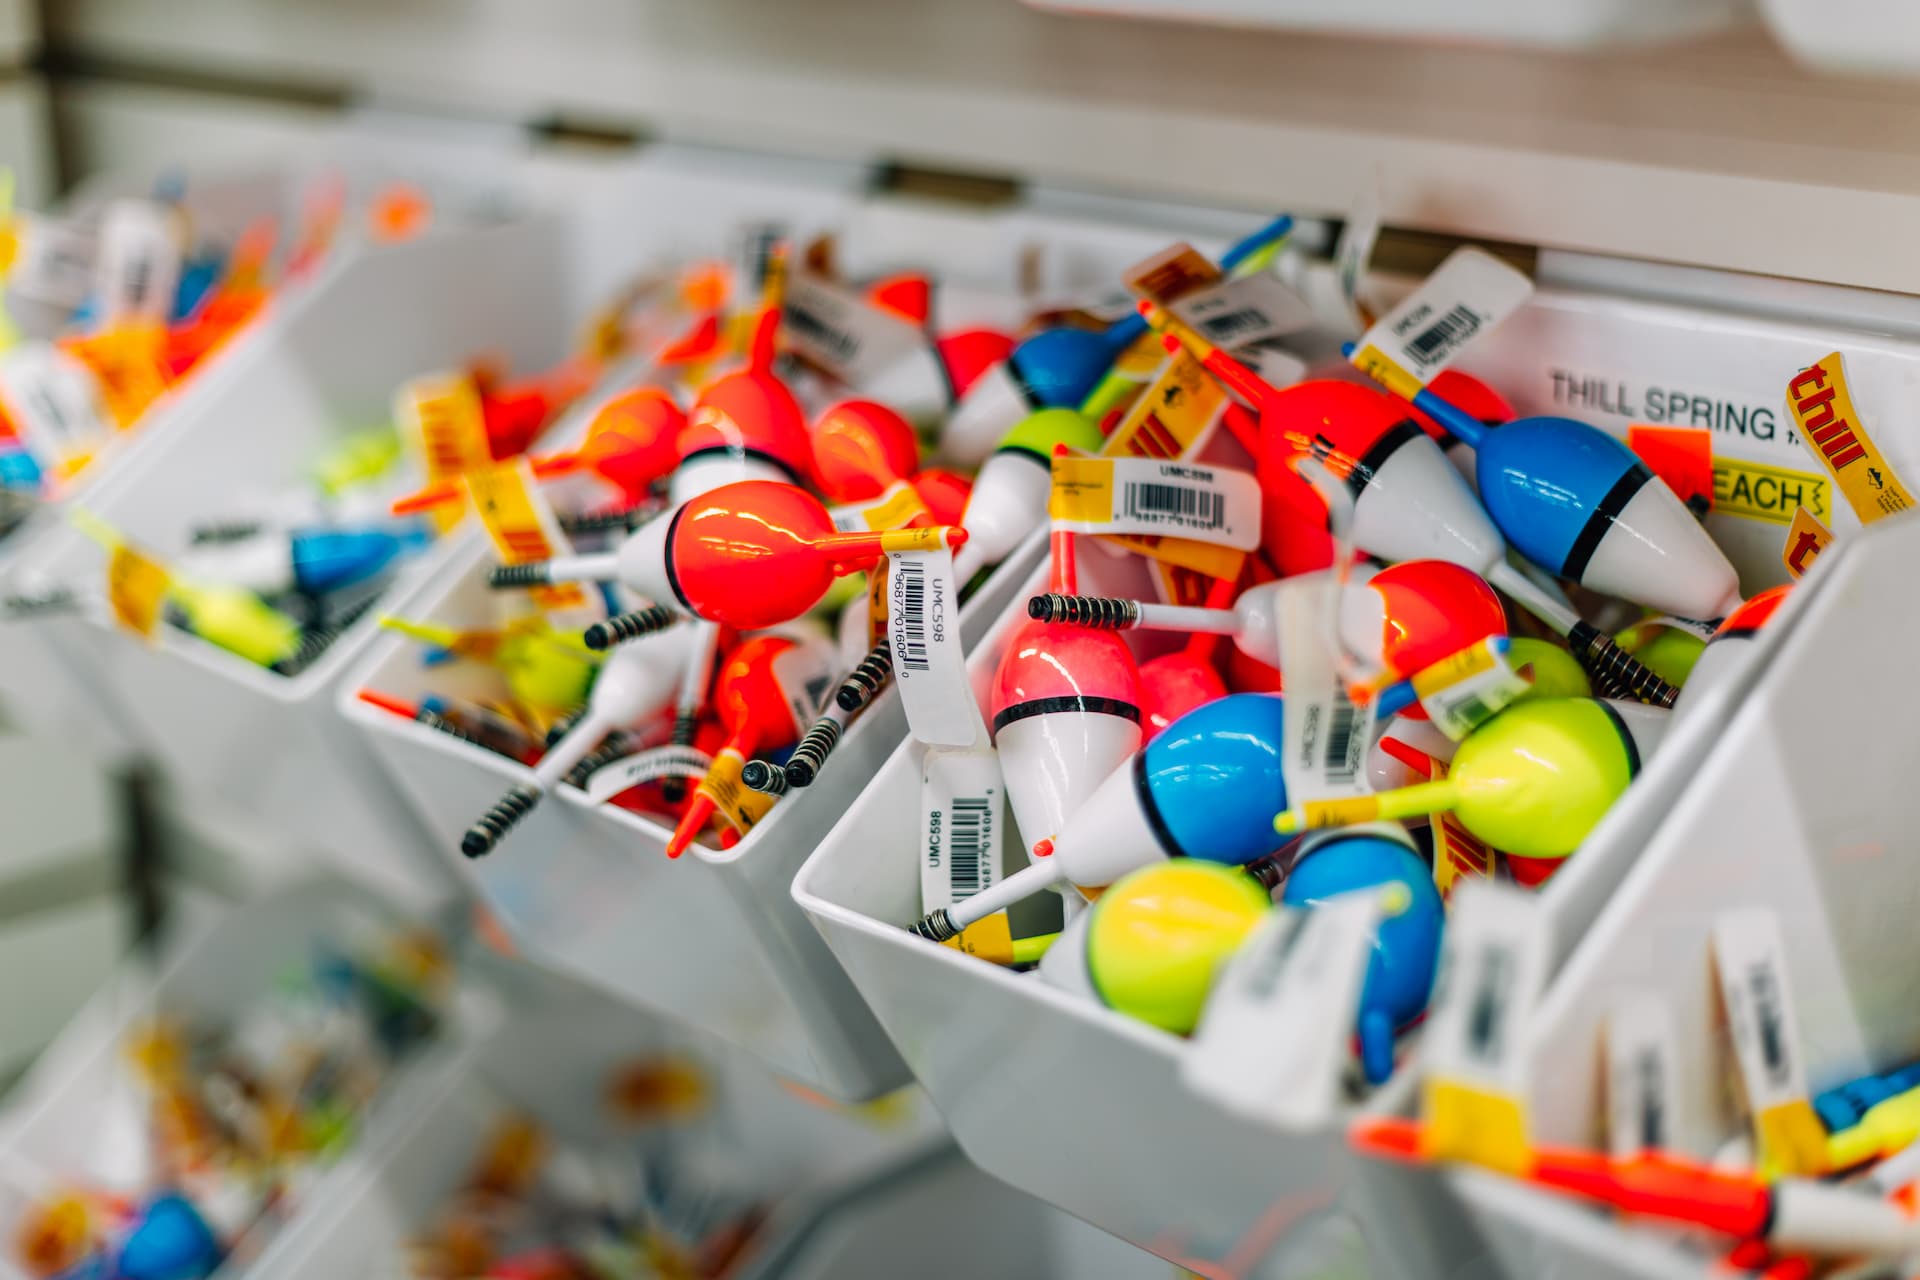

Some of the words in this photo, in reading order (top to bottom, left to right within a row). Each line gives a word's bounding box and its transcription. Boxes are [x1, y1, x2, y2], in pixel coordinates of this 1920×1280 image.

[1551, 371, 1636, 418] THILL
[1645, 385, 1775, 440] SPRING
[1789, 363, 1868, 473] thill
[1713, 467, 1803, 512] EACH
[931, 578, 944, 643] UMC598
[929, 810, 942, 868] UMC598
